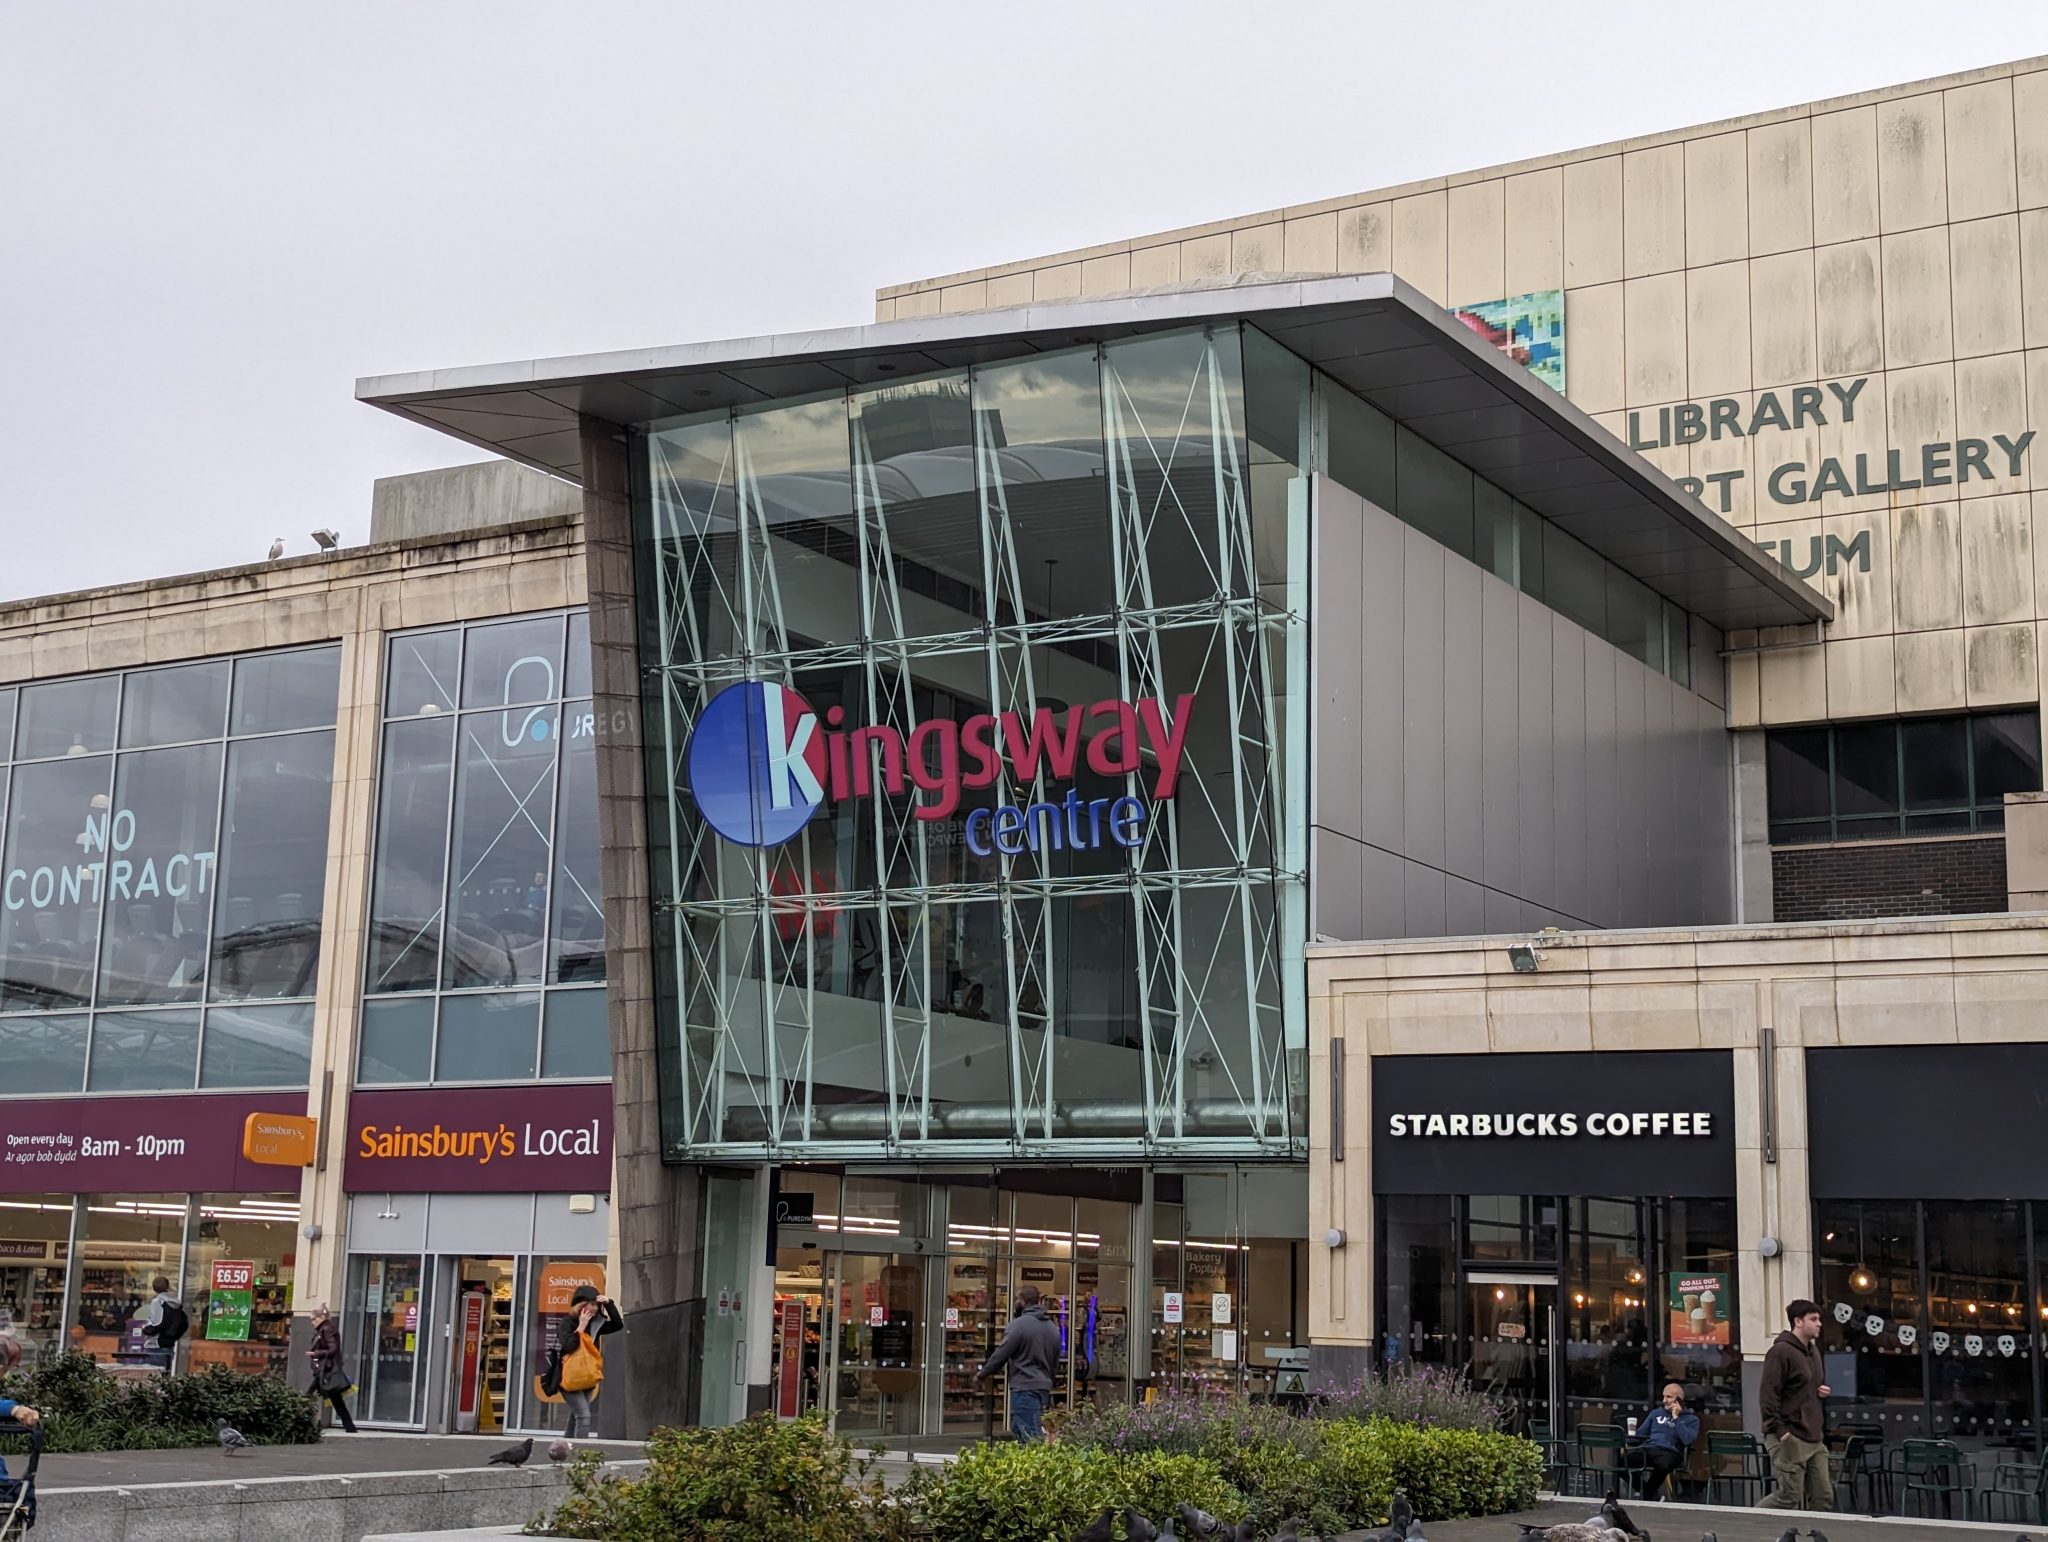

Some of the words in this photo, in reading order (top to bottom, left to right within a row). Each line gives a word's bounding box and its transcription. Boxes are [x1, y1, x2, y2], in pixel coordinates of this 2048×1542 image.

[1629, 378, 1868, 451] LIBRARY
[1674, 470, 1745, 516] RT
[1768, 431, 2037, 505] GALLERY
[84, 809, 136, 854] NO
[966, 787, 1147, 857] centre
[4, 852, 215, 910] CONTRACT
[1389, 1113, 1578, 1136] STARBUCKS
[1586, 1112, 1711, 1135] COFFEE
[7, 1134, 29, 1147] Open
[31, 1135, 55, 1147] every
[56, 1132, 73, 1147] day
[81, 1136, 119, 1156] 8am
[136, 1135, 185, 1161] 10pm
[256, 1144, 278, 1153] Local
[360, 1124, 515, 1164] Sainsbury's
[524, 1119, 600, 1156] Local
[5, 1151, 15, 1162] Ar
[16, 1153, 35, 1165] agor
[37, 1150, 52, 1162] bob
[54, 1150, 77, 1165] dydd
[1186, 1252, 1221, 1264] Bakery
[216, 1269, 248, 1284] £6.50
[549, 1276, 595, 1288] Sainsbury's
[548, 1295, 569, 1304] Local
